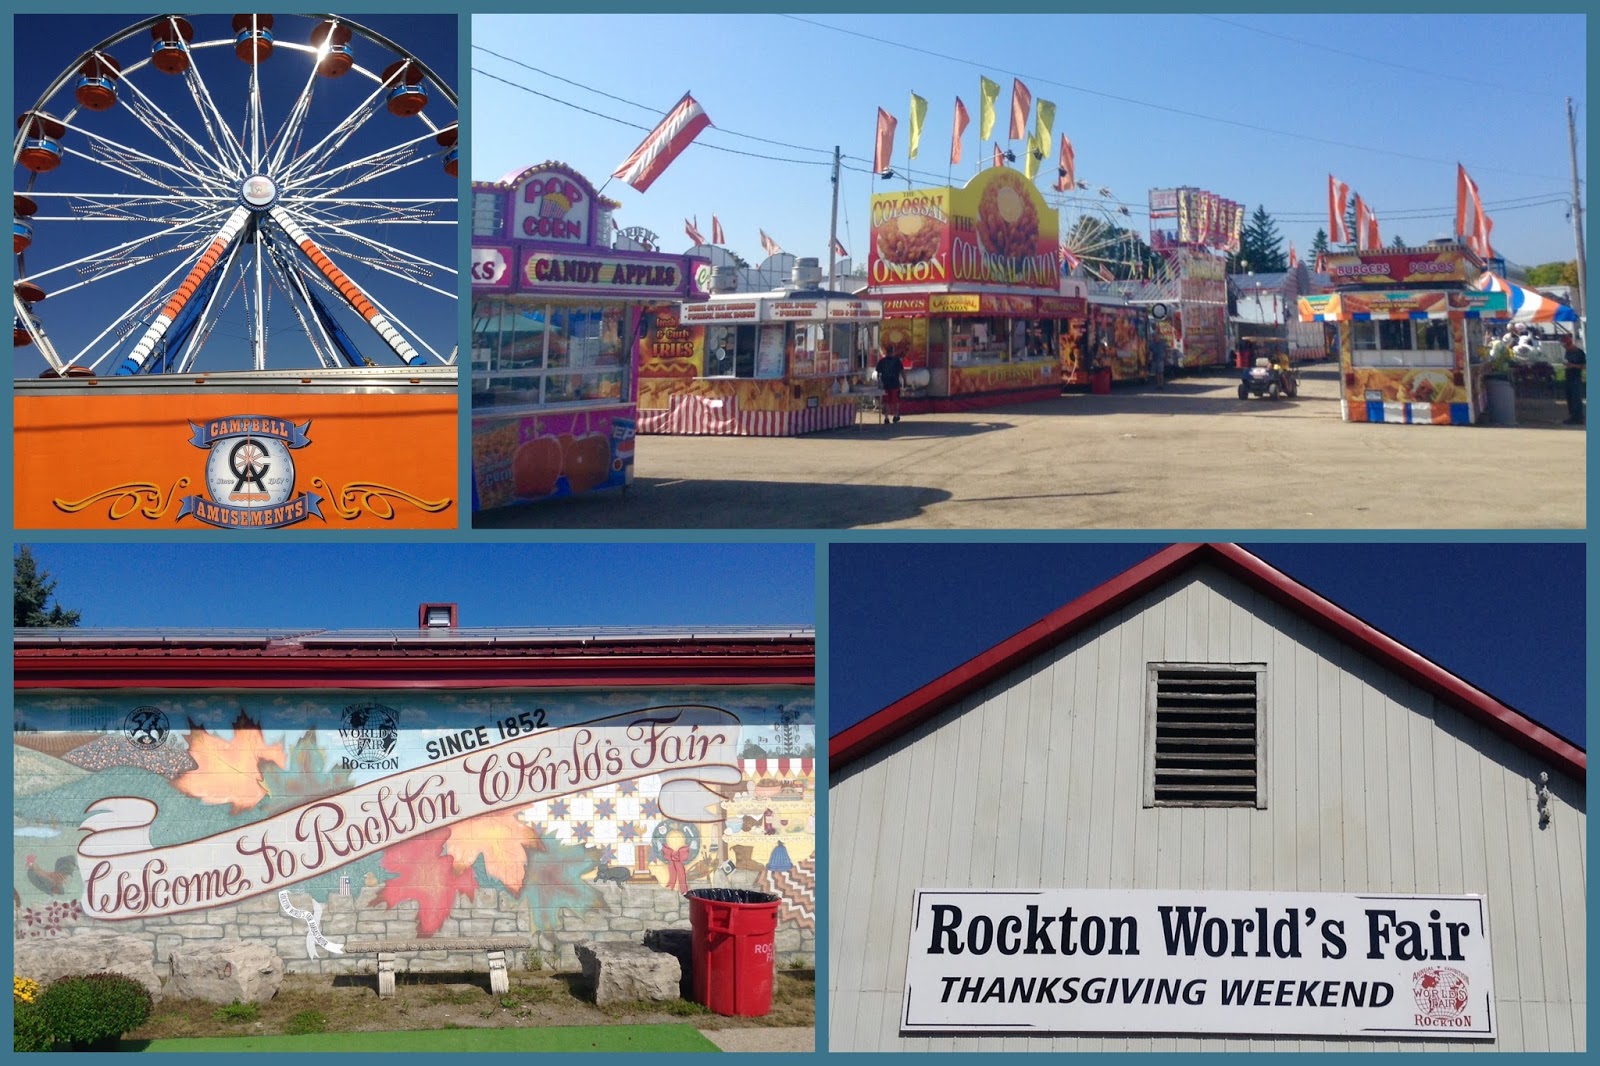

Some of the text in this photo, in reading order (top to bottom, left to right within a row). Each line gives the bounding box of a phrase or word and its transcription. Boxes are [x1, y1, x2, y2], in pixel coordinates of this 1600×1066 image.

[525, 177, 583, 209] POP
[873, 195, 948, 228] COLOSSAL
[953, 214, 974, 233] THE
[523, 215, 581, 239] CORN
[535, 258, 603, 284] CANDY
[612, 263, 676, 286] APPLES
[873, 252, 947, 283] ONION
[952, 236, 1058, 286] COLOSSAL ONION
[1337, 261, 1455, 276] BURGERS POGOS
[210, 418, 289, 437] CAMPBELL
[196, 500, 304, 527] AMUSEMENTS
[357, 739, 384, 750] FAIR
[425, 708, 549, 760] SINCE 1852
[342, 756, 399, 770] ROCKTON
[87, 708, 726, 914] Welcome to Rockton World's Fair
[927, 904, 1470, 962] Rockton World's Fair
[940, 976, 1395, 1008] THANKSGIVING WEEKEND
[1432, 999, 1456, 1010] FAIR
[1414, 1014, 1472, 1027] ROCKTON
